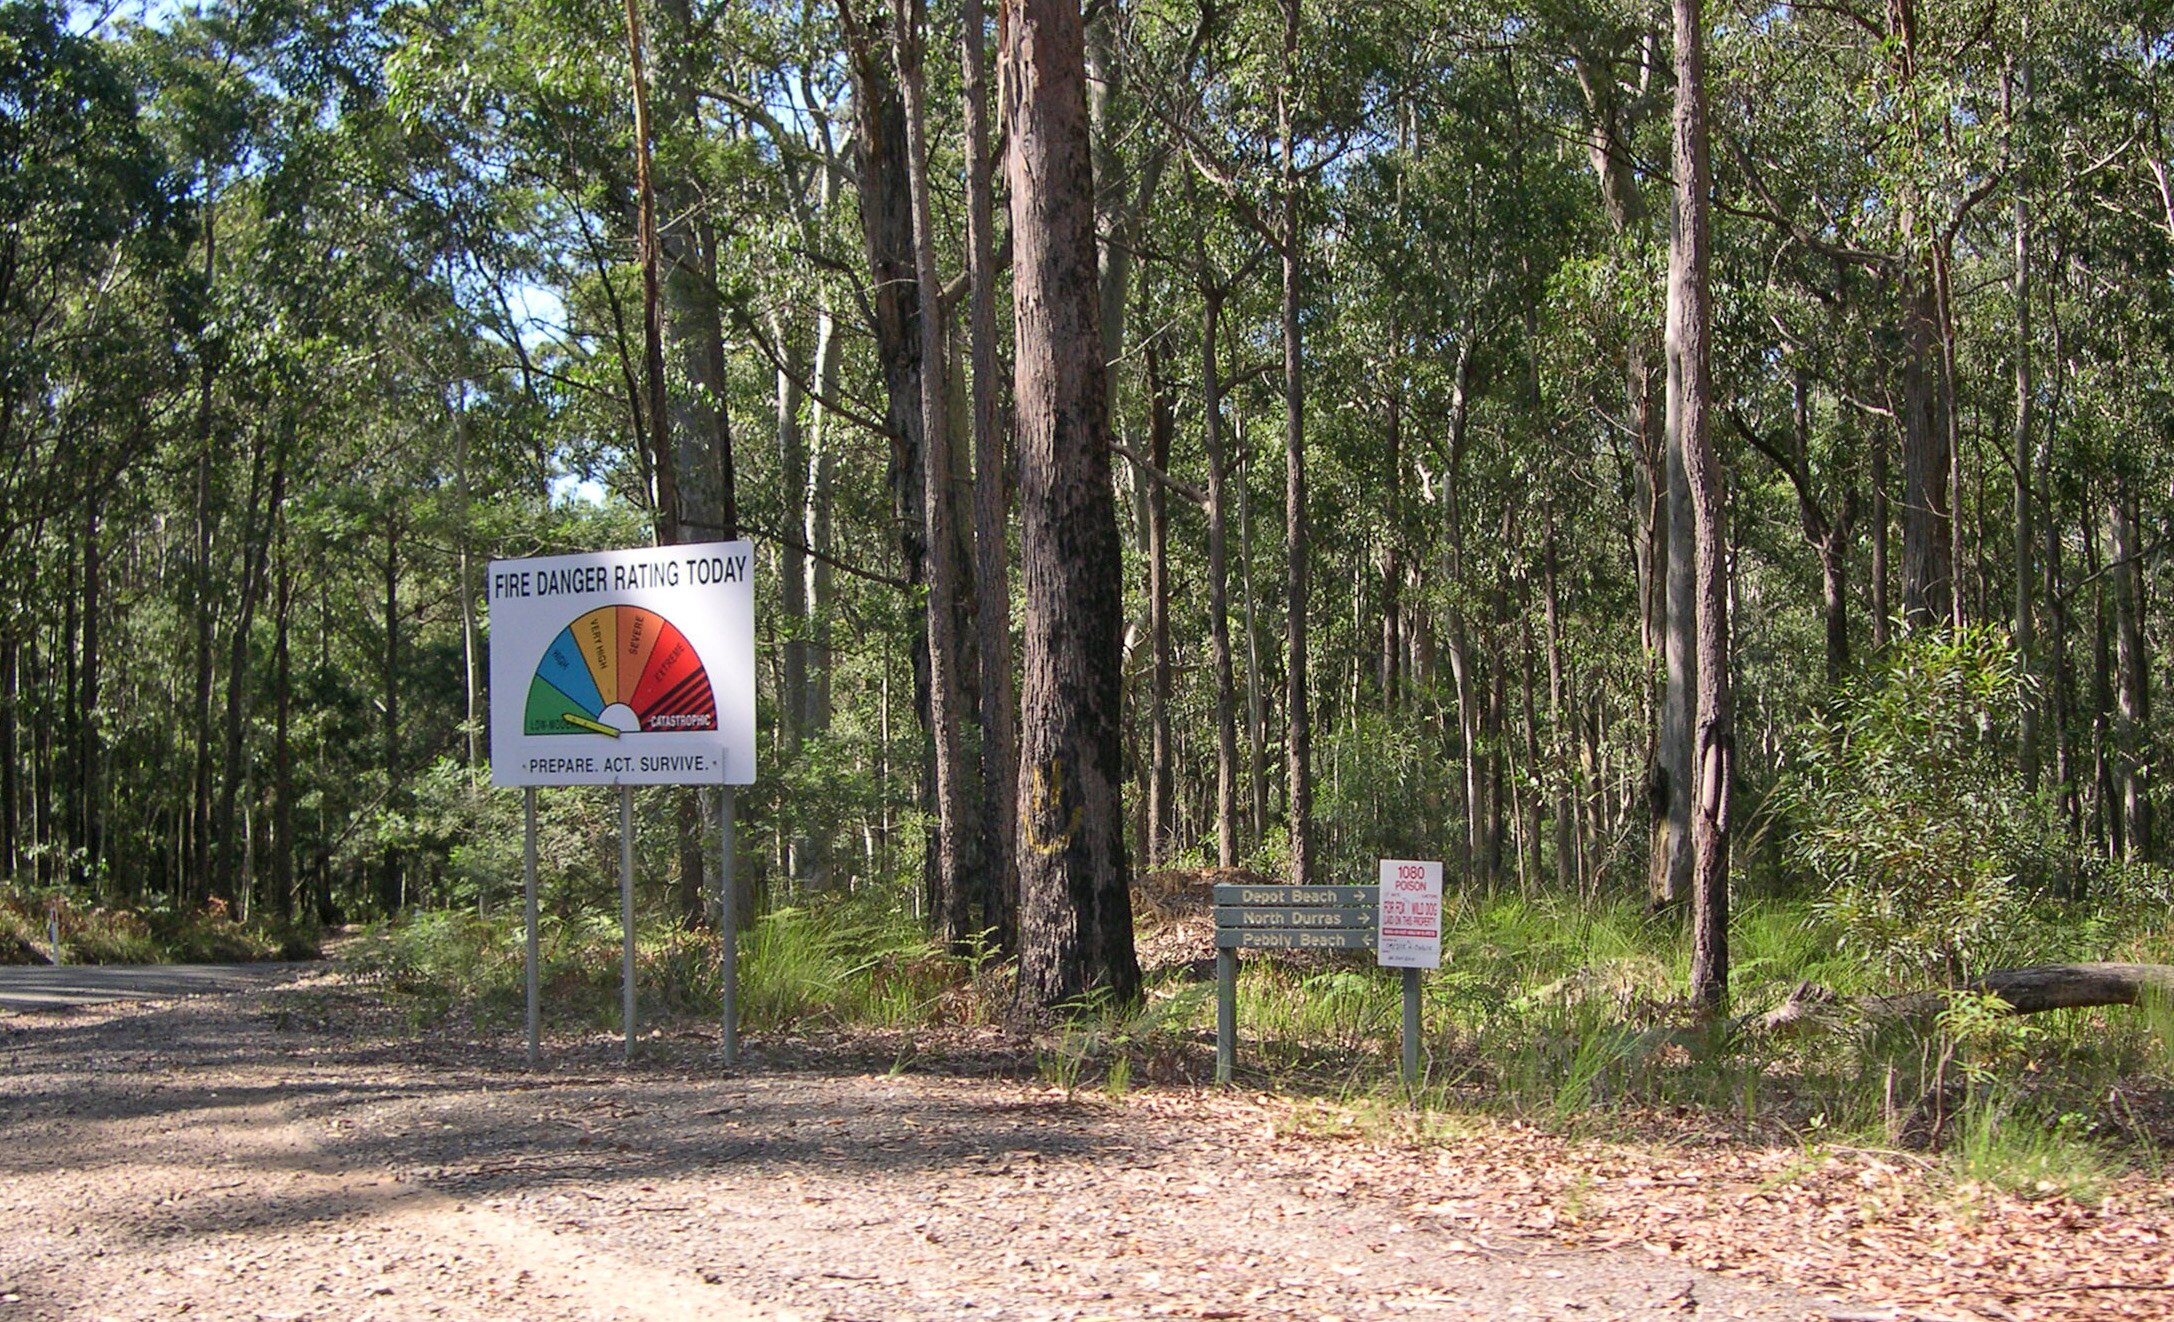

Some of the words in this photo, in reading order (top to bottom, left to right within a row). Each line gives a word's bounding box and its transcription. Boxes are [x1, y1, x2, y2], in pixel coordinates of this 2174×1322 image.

[495, 572, 531, 599] FIRE
[537, 566, 607, 596] DANGER
[614, 561, 679, 590] RATING
[686, 555, 747, 584] TODAY
[628, 616, 645, 655] SEVERE
[589, 618, 602, 644] VERY
[596, 645, 608, 670] HIGH
[552, 649, 570, 671] HIGH
[655, 642, 685, 682] EXTREME
[650, 714, 711, 728] CATASTROPHIC
[529, 758, 599, 774] PREPARE.
[604, 757, 635, 773] ACT.
[640, 756, 709, 772] SURVIVE.
[1398, 866, 1425, 879] 1080
[1395, 880, 1427, 891] POISON
[1242, 890, 1285, 903] Depot
[1292, 889, 1337, 902] Beach
[1243, 911, 1285, 924] North
[1292, 912, 1342, 924] Durras
[1243, 934, 1292, 948] Pebbly
[1301, 934, 1345, 947] Beach
